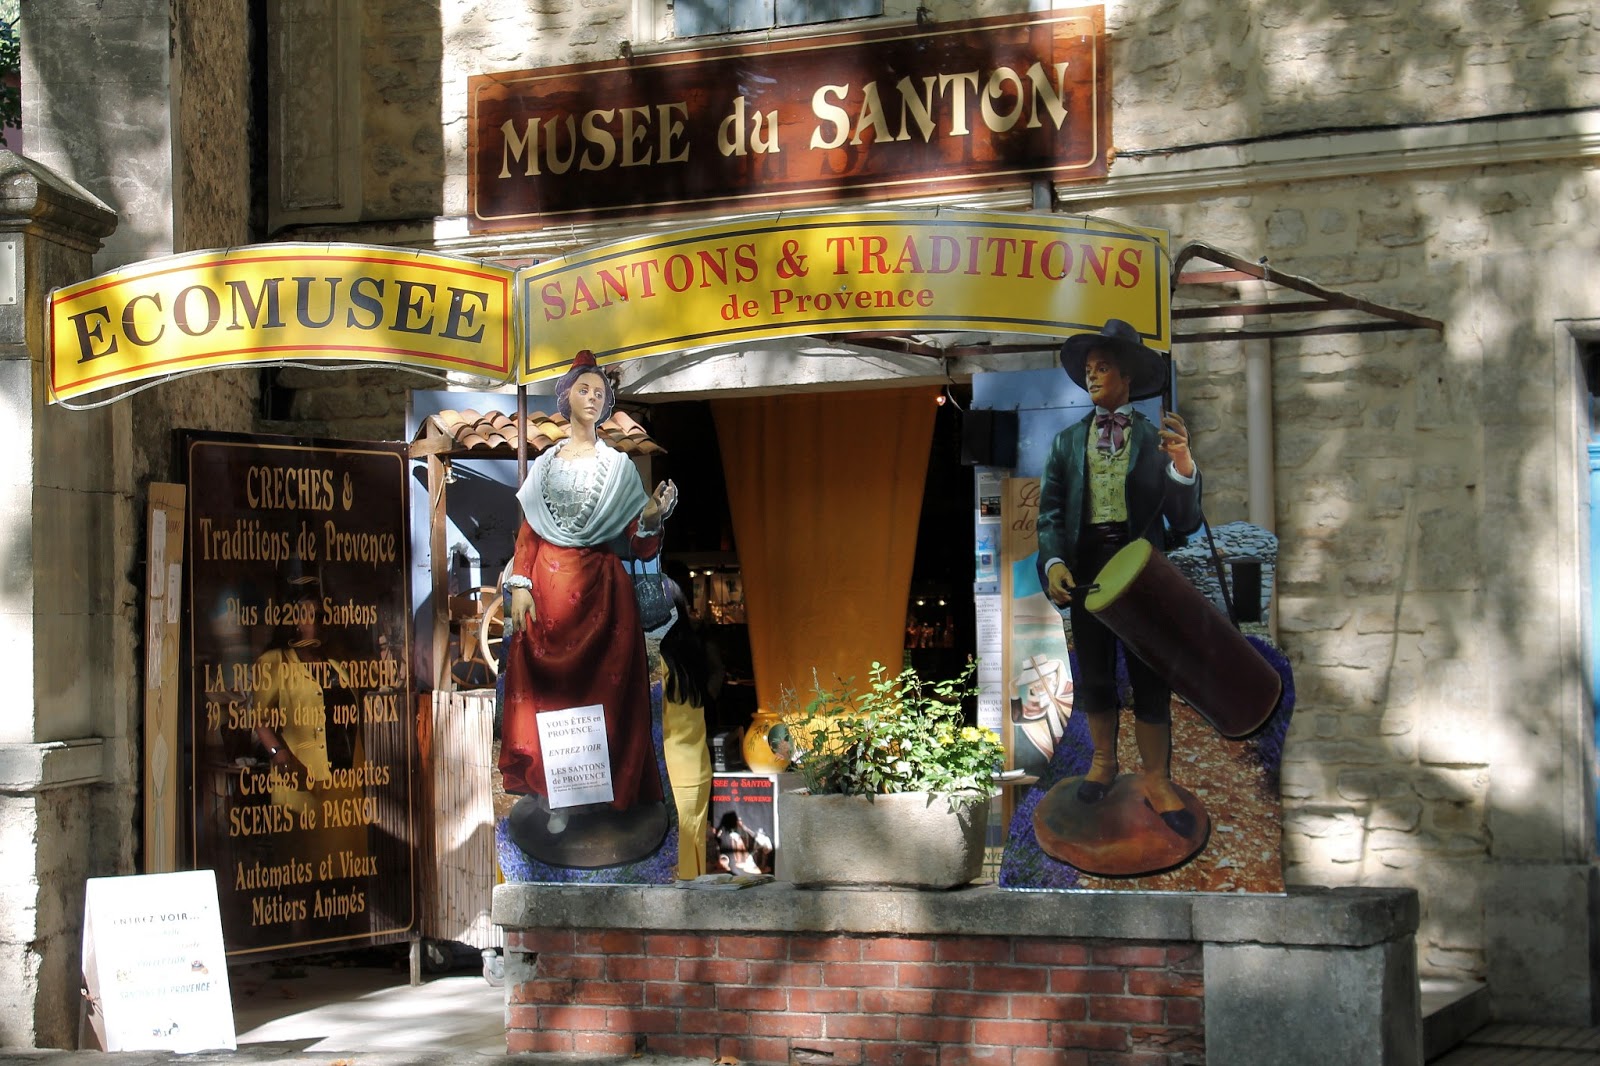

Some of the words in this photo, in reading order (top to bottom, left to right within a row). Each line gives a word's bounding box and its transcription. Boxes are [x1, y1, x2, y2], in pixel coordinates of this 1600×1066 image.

[498, 101, 690, 179] MUSEE
[716, 96, 781, 158] du
[809, 61, 1070, 151] SANTON
[542, 243, 760, 322] SANTONS
[775, 239, 810, 278] &
[826, 235, 1143, 289] TRADITIONS
[67, 276, 490, 365] ECOMUSEE
[720, 293, 759, 321] de
[771, 285, 935, 316] Provence
[247, 466, 334, 511] CRECHES
[342, 471, 353, 510] &
[200, 518, 290, 570] Traditions
[298, 520, 316, 561] de
[324, 520, 396, 571] Provence
[226, 597, 257, 626] Plus
[264, 598, 281, 626] de
[282, 603, 316, 626] 2000
[323, 597, 378, 630] Santons
[204, 664, 226, 693] LA
[233, 662, 273, 692] PLUS
[277, 660, 332, 691] PETITE
[339, 659, 399, 689] CRECHE
[205, 703, 221, 731] 39
[228, 700, 288, 732] Santons
[293, 703, 327, 728] dans
[333, 703, 358, 728] une
[363, 695, 400, 723] NOIX
[546, 718, 569, 729] VOUS
[571, 716, 592, 727] ÊTES
[549, 745, 581, 757] ENTREZ
[582, 743, 602, 752] VOIR
[240, 765, 299, 796] Creches
[322, 760, 390, 791] Scenettes
[551, 766, 567, 776] LES
[568, 762, 606, 773] SANTONS
[552, 777, 562, 785] de
[563, 771, 606, 784] PROVENCE
[741, 778, 772, 788] SANTON
[229, 803, 294, 837] SCENES
[300, 802, 317, 831] de
[323, 796, 382, 829] PAGNOL
[235, 858, 313, 892] Automates
[319, 855, 333, 881] et
[340, 850, 378, 877] Vieux
[251, 892, 307, 927] Métiers
[313, 884, 365, 925] Animés
